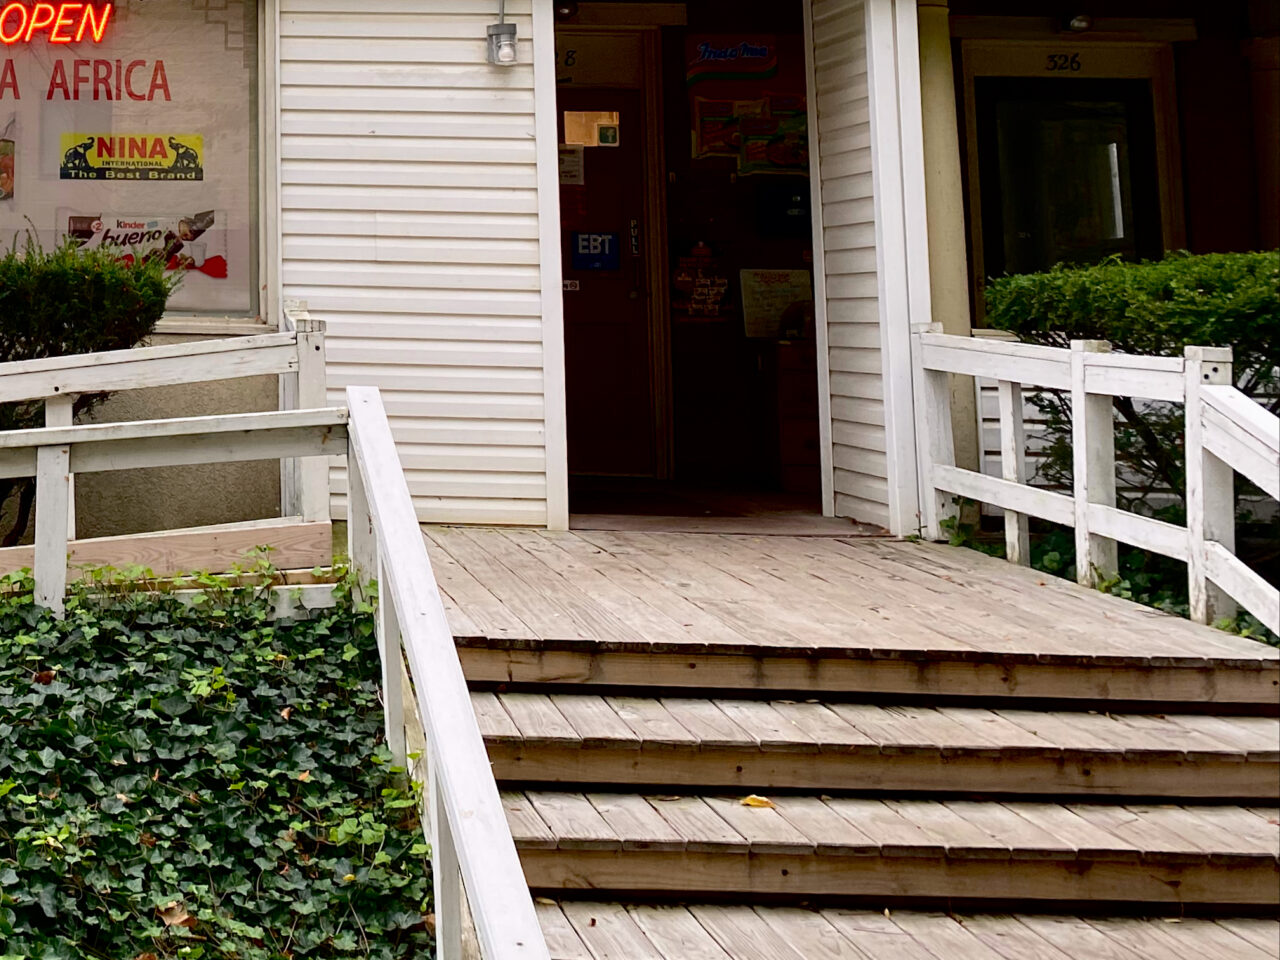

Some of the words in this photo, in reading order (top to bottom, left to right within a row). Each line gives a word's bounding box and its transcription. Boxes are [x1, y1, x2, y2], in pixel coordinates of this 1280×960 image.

[1046, 53, 1081, 71] 326
[47, 59, 172, 101] AFRICA
[97, 138, 168, 158] NINA
[101, 160, 164, 168] INTERNATIONAL
[69, 170, 97, 180] The
[106, 170, 142, 180] Best
[149, 170, 196, 180] Brand
[102, 227, 162, 246] bueno
[578, 235, 613, 255] EBT
